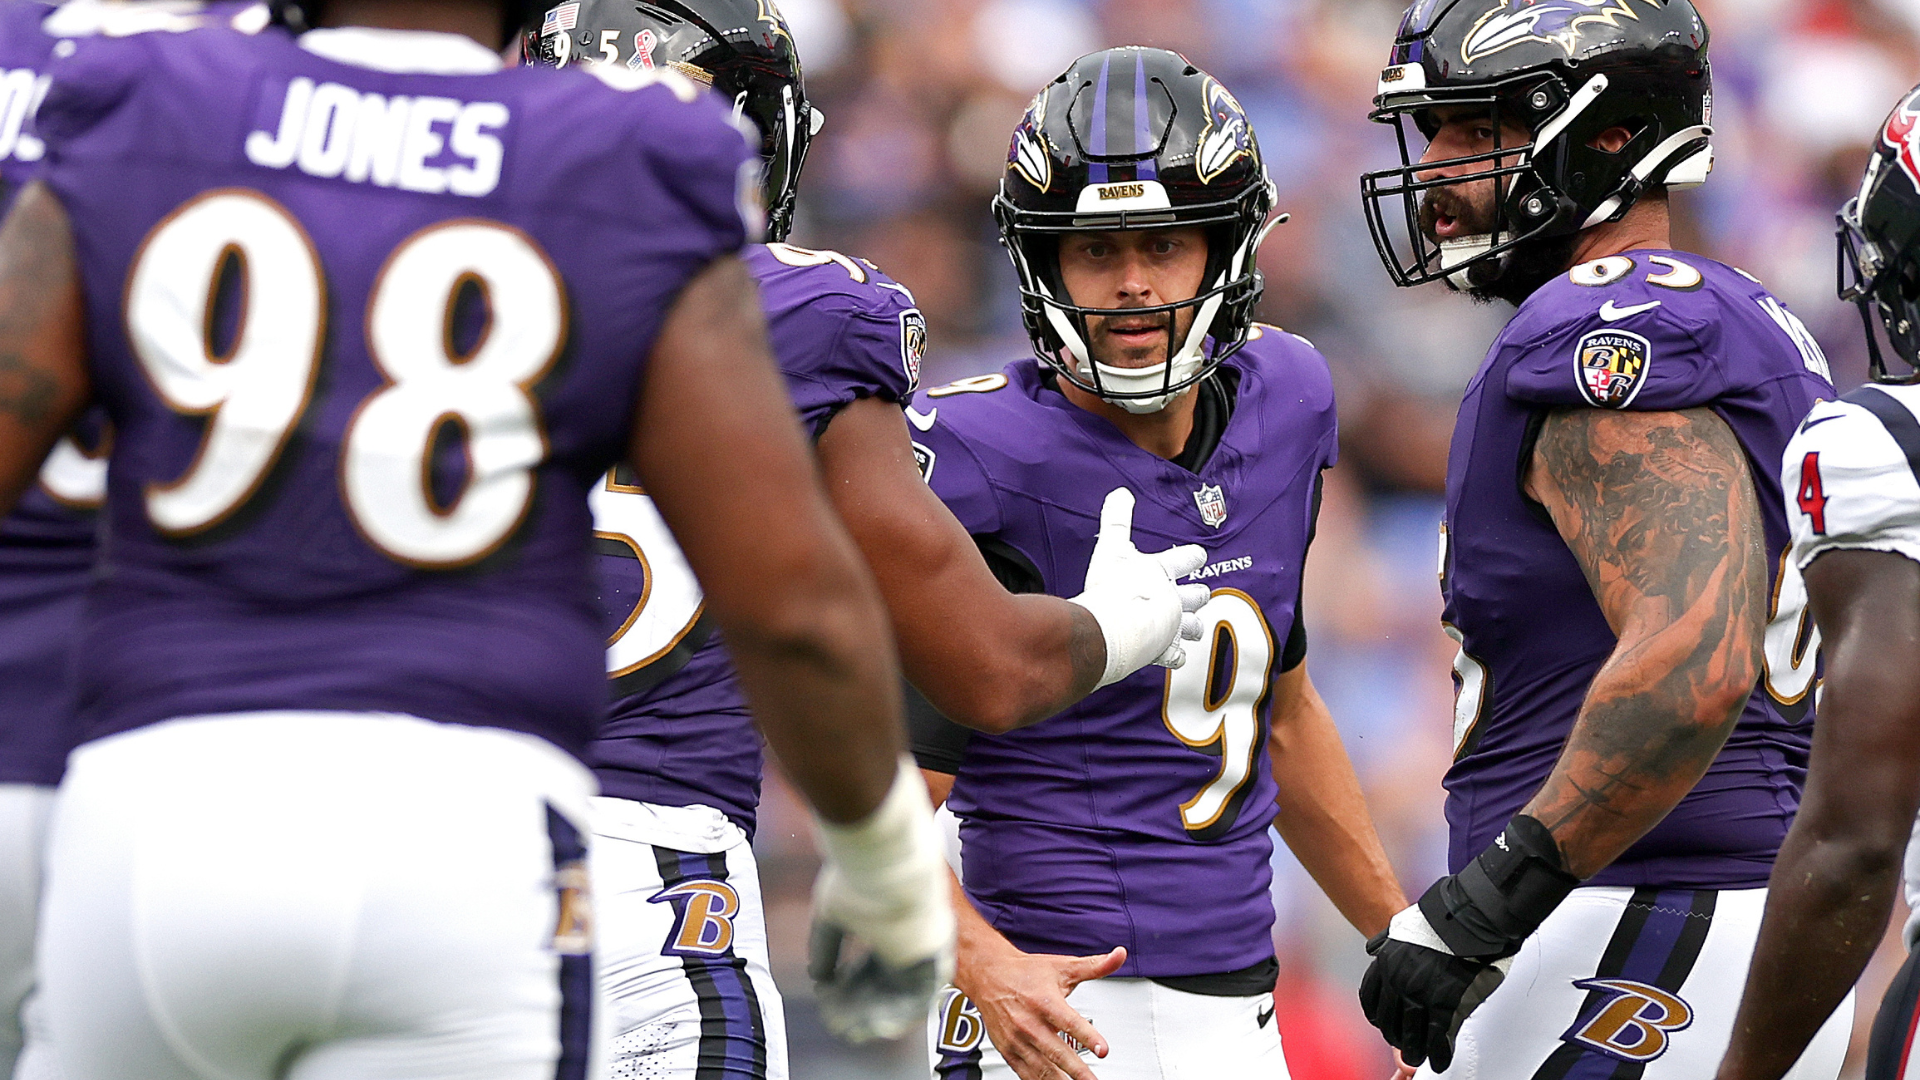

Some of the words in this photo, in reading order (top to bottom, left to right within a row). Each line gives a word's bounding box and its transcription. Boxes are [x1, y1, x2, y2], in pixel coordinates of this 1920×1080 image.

[245, 77, 510, 197] JONES
[1097, 184, 1144, 200] RAVENS
[121, 187, 569, 569] 98
[1586, 336, 1642, 352] RAVENS
[1203, 501, 1225, 520] NFL
[1797, 450, 1830, 535] 4
[1188, 556, 1253, 581] RAVENS
[1162, 587, 1274, 831] 9
[647, 878, 741, 958] B
[1560, 976, 1694, 1063] B
